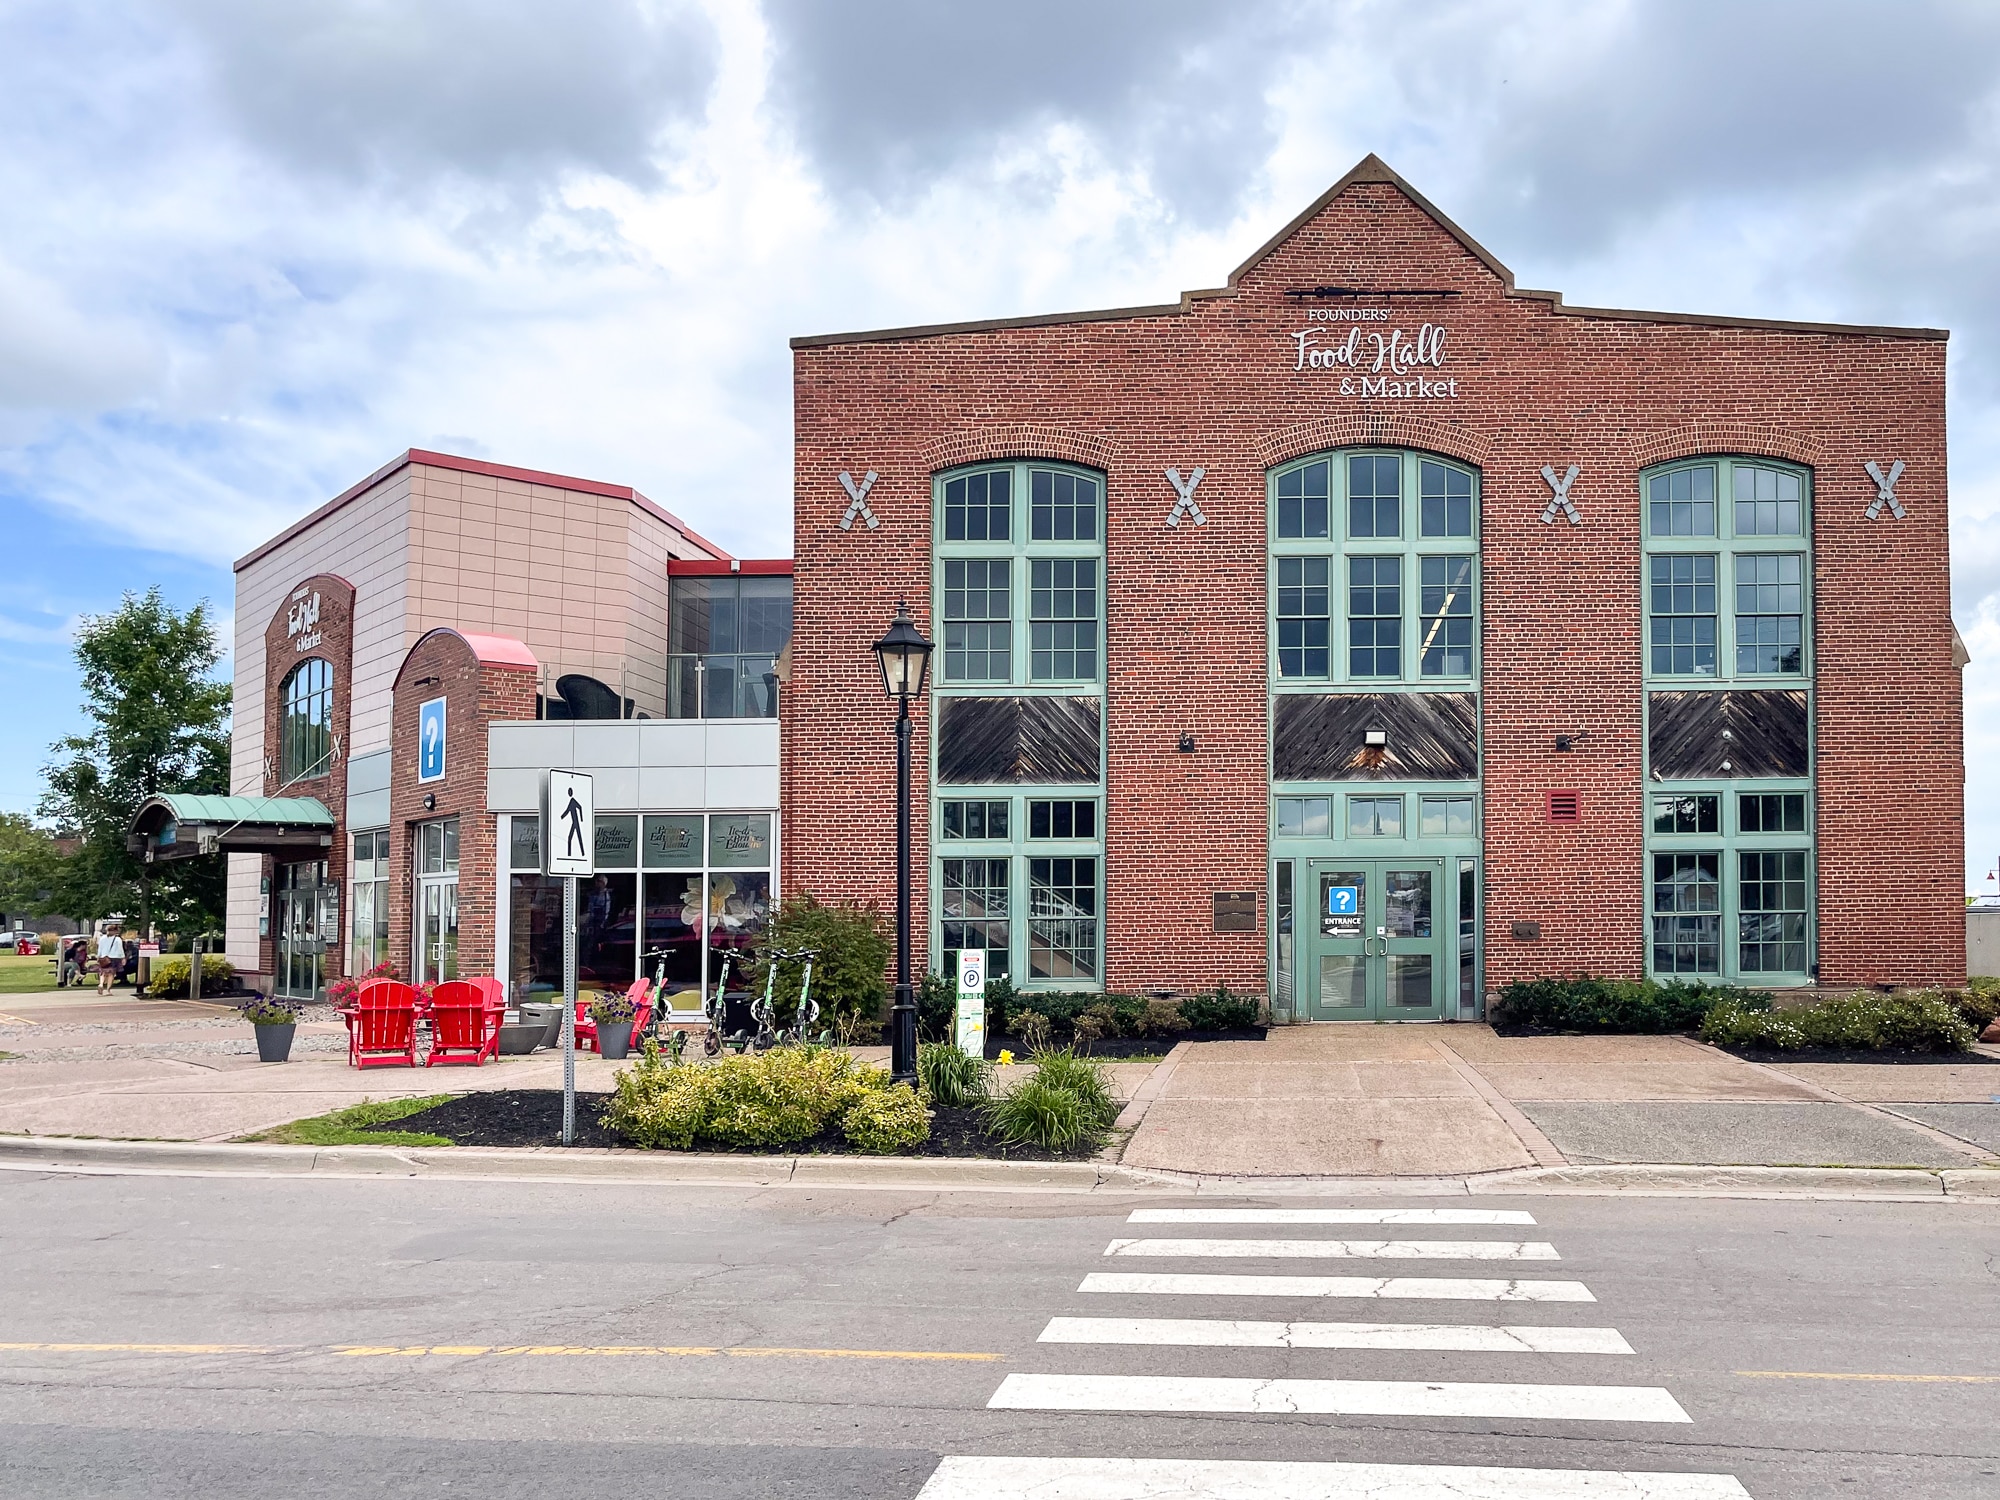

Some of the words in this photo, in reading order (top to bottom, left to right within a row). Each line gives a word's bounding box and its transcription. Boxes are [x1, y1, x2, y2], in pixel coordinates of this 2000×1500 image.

[1308, 309, 1391, 321] FOUNDERS'
[1290, 326, 1364, 371] Food
[1367, 323, 1446, 375] Hall
[1339, 377, 1356, 396] &
[1360, 376, 1459, 398] Market
[300, 629, 322, 653] Market
[1324, 917, 1361, 925] ENTRANCE
